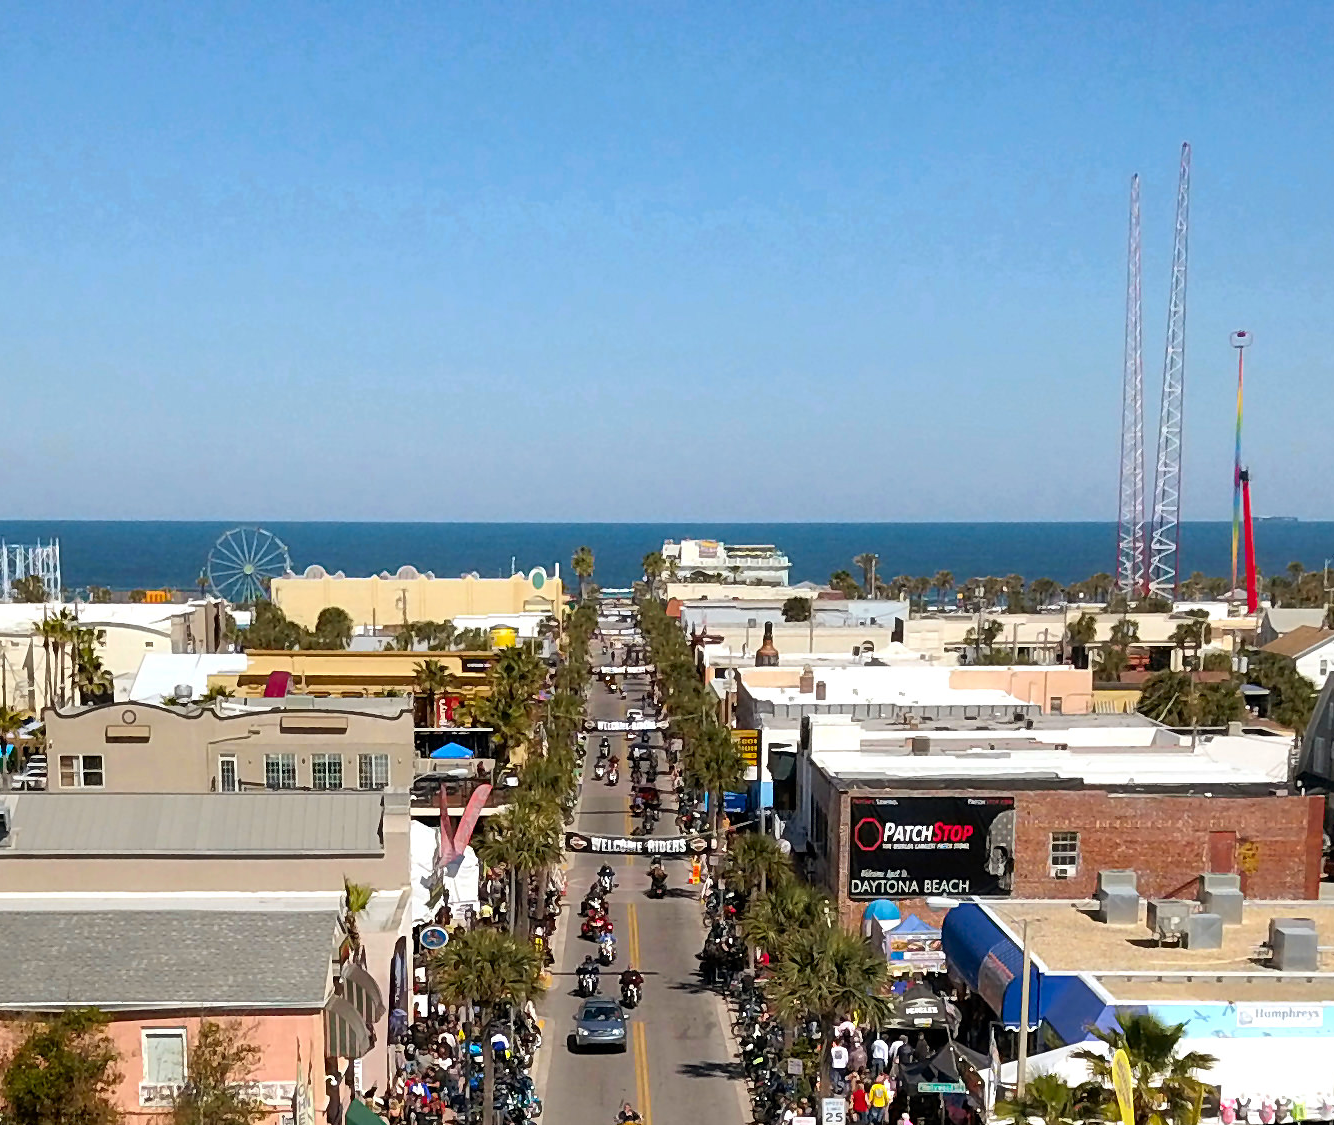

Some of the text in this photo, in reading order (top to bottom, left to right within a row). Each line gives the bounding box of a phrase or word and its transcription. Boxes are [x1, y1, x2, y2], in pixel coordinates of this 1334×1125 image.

[591, 837, 687, 853] WELCOME RIDERS
[851, 879, 970, 894] DAYTONA BEACH
[1255, 1007, 1320, 1020] Humphreys
[825, 1112, 843, 1123] 25
